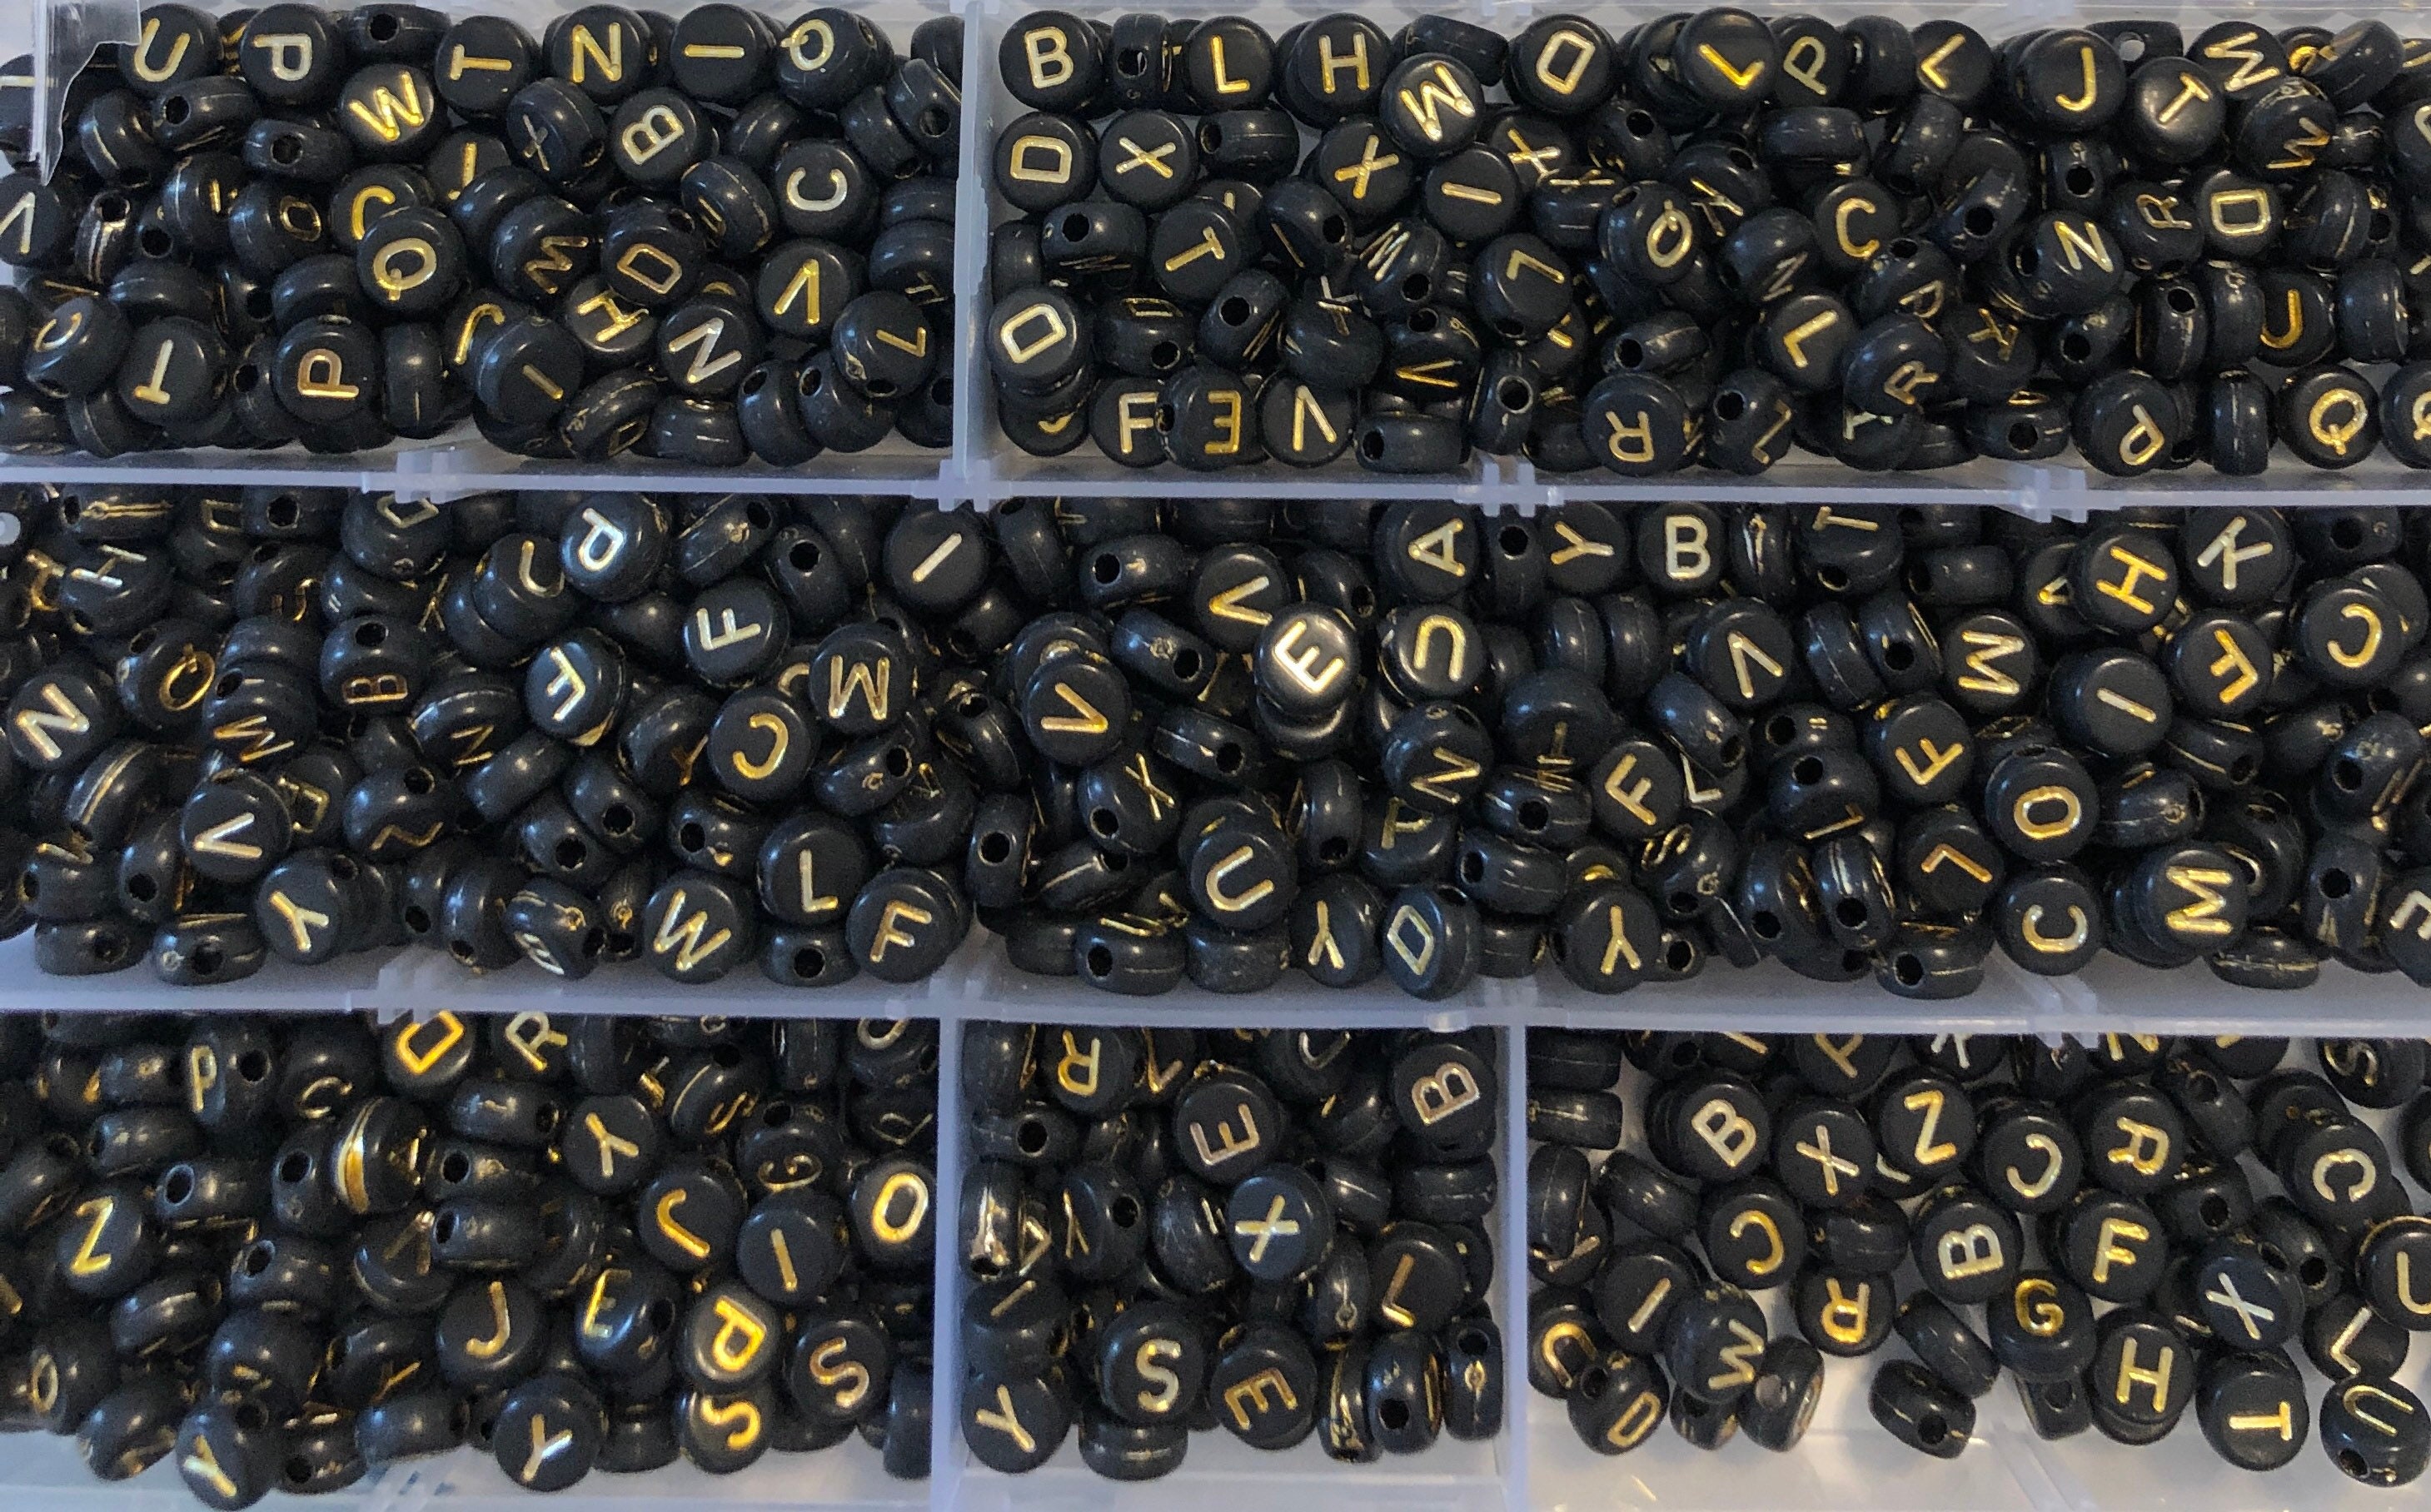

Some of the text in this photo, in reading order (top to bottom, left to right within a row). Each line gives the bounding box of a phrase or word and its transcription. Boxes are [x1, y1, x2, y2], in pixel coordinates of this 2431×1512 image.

[135, 17, 191, 82] U
[254, 33, 312, 82] P
[449, 44, 512, 81] T
[572, 22, 621, 82] N
[684, 44, 745, 58] I
[781, 19, 834, 71] Q
[1024, 27, 1074, 89] B
[1212, 35, 1250, 93] L
[1319, 32, 1370, 93] H
[1537, 32, 1596, 94] D
[1698, 43, 1765, 89] L
[1785, 37, 1827, 95] P
[1921, 34, 1966, 90] L
[2055, 47, 2095, 112] J
[2159, 72, 2209, 124] T
[523, 114, 550, 171] X
[621, 105, 685, 165] B
[1010, 136, 1072, 183] D
[1117, 137, 1176, 177] X
[787, 167, 848, 211] C
[1335, 135, 1399, 199] X
[1441, 182, 1501, 205] I
[1647, 200, 1692, 267] Q
[1835, 197, 1880, 258] C
[2137, 194, 2192, 230] R
[2211, 189, 2270, 236] D
[373, 238, 436, 301] Q
[617, 249, 682, 295] D
[1166, 226, 1224, 271] T
[1507, 250, 1565, 283] L
[2055, 221, 2114, 272] N
[578, 290, 649, 341] H
[774, 258, 819, 324] V
[2260, 290, 2301, 349] J
[1001, 304, 1066, 363] D
[1784, 311, 1839, 368] L
[134, 340, 172, 404] T
[298, 349, 359, 399] P
[523, 364, 563, 400] I
[1396, 358, 1463, 389] V
[1884, 361, 1938, 404] R
[1119, 391, 1161, 455] F
[1205, 390, 1241, 454] E
[1293, 385, 1337, 450] V
[1606, 410, 1654, 462] R
[2120, 405, 2164, 465] P
[2310, 387, 2368, 455] Q
[578, 508, 625, 572] P
[1407, 518, 1464, 576] A
[1551, 520, 1615, 565] Y
[1665, 515, 1711, 579] B
[1813, 506, 1879, 531] T
[72, 545, 147, 589] H
[913, 532, 962, 582] I
[2097, 546, 2167, 614] H
[2198, 516, 2272, 589] K
[695, 607, 761, 651] F
[1210, 575, 1273, 626] V
[1272, 619, 1345, 694] E
[1416, 614, 1466, 684] U
[1727, 632, 1783, 698] V
[2211, 628, 2258, 704] F
[2328, 603, 2382, 668] C
[159, 644, 216, 711] Q
[341, 674, 409, 704] B
[548, 646, 586, 721] F
[1040, 682, 1108, 733] V
[2097, 688, 2156, 722] I
[733, 714, 789, 779] C
[1895, 738, 1963, 785] F
[1124, 754, 1176, 820] X
[1604, 754, 1656, 826] F
[2013, 785, 2080, 841] O
[193, 812, 262, 858] V
[1921, 843, 1993, 883] L
[800, 849, 838, 913] L
[1206, 845, 1275, 913] U
[269, 890, 330, 952] Y
[870, 900, 932, 962] F
[1308, 899, 1345, 970] Y
[1601, 904, 1641, 975] Y
[2022, 904, 2088, 953] C
[506, 1011, 567, 1072] R
[1058, 1029, 1101, 1097] R
[192, 1045, 217, 1112] P
[1411, 1062, 1479, 1126] B
[585, 1112, 640, 1176] Y
[1190, 1102, 1260, 1166] E
[1691, 1097, 1756, 1167] B
[1904, 1090, 1956, 1165] Z
[2108, 1117, 2169, 1176] R
[1796, 1125, 1860, 1196] X
[2007, 1134, 2062, 1198] C
[2312, 1148, 2376, 1202] C
[70, 1196, 114, 1275] Z
[657, 1189, 710, 1258] J
[872, 1173, 929, 1242] O
[1235, 1193, 1299, 1263] X
[770, 1228, 798, 1291] I
[1731, 1210, 1784, 1275] C
[1937, 1223, 2003, 1280] B
[2093, 1217, 2150, 1283] F
[466, 1280, 511, 1356] J
[1382, 1254, 1415, 1329] L
[1628, 1277, 1671, 1332] I
[1821, 1278, 1869, 1343] R
[2014, 1279, 2065, 1335] G
[2205, 1272, 2274, 1340] X
[715, 1295, 767, 1373] P
[2332, 1306, 2372, 1375] L
[809, 1335, 870, 1408] S
[1137, 1339, 1180, 1412] S
[1224, 1367, 1297, 1430] E
[2116, 1335, 2174, 1413] H
[700, 1398, 761, 1450] S
[977, 1385, 1035, 1453] Y
[1607, 1391, 1660, 1447] D
[2229, 1400, 2292, 1441] T
[2343, 1385, 2414, 1435] U
[521, 1414, 573, 1483] Y
